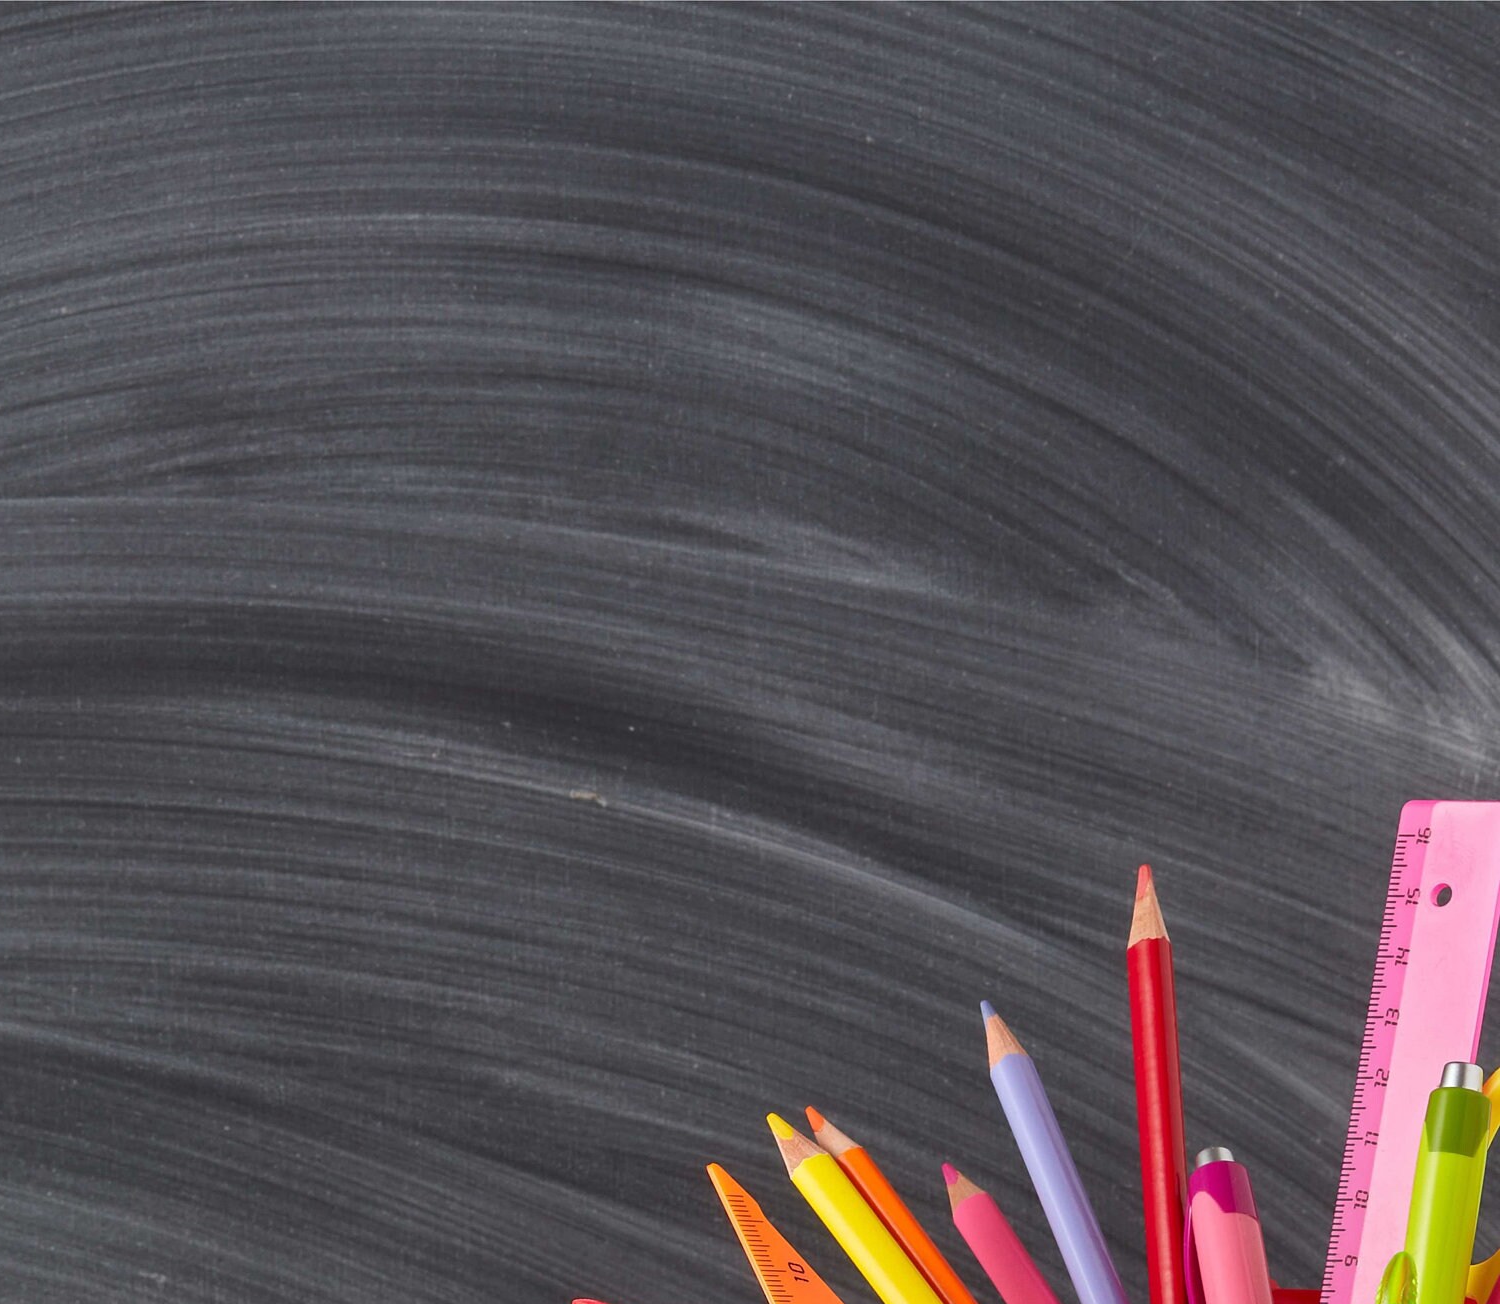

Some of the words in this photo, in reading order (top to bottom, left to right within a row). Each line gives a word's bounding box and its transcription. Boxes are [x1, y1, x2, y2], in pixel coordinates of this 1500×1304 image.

[1416, 827, 1432, 845] 16
[1405, 887, 1421, 906] 15
[1394, 947, 1410, 966] 14
[1384, 1007, 1400, 1027] 13
[1373, 1067, 1390, 1088] 12
[1364, 1130, 1380, 1146] 11
[1353, 1189, 1369, 1209] 10
[1344, 1254, 1358, 1267] 9
[787, 1261, 809, 1283] 10
